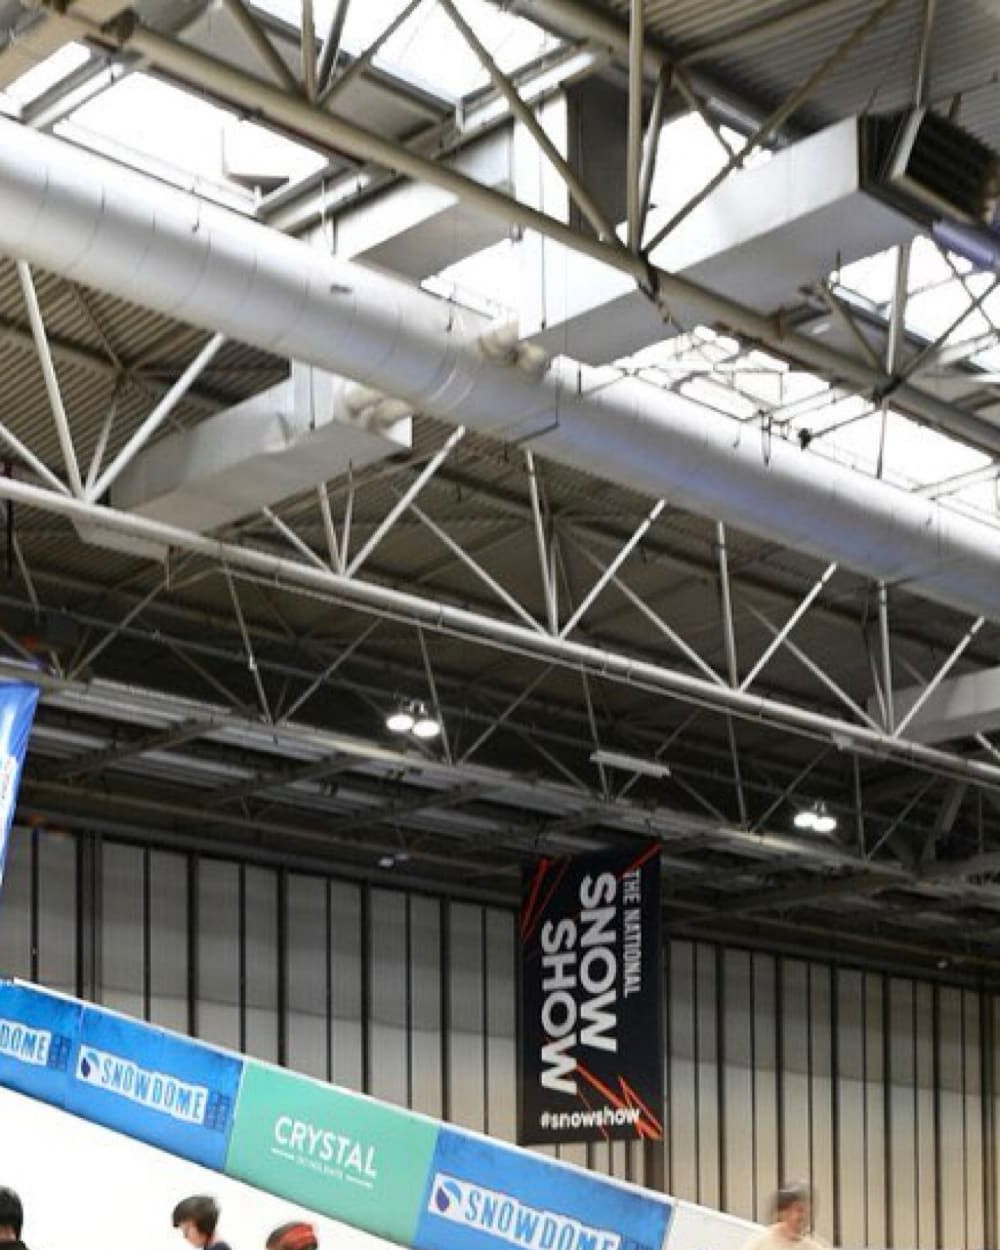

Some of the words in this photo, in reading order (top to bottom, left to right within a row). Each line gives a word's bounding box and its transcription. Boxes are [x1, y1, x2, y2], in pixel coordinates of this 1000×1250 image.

[623, 867, 642, 905] THE
[580, 871, 618, 1052] SNOW
[623, 908, 643, 999] NATIONAL
[541, 918, 578, 1095] SHOW
[101, 1055, 202, 1120] SNOWDOME
[541, 1104, 640, 1130] #snowshow
[274, 1116, 377, 1178] CRYSTAL
